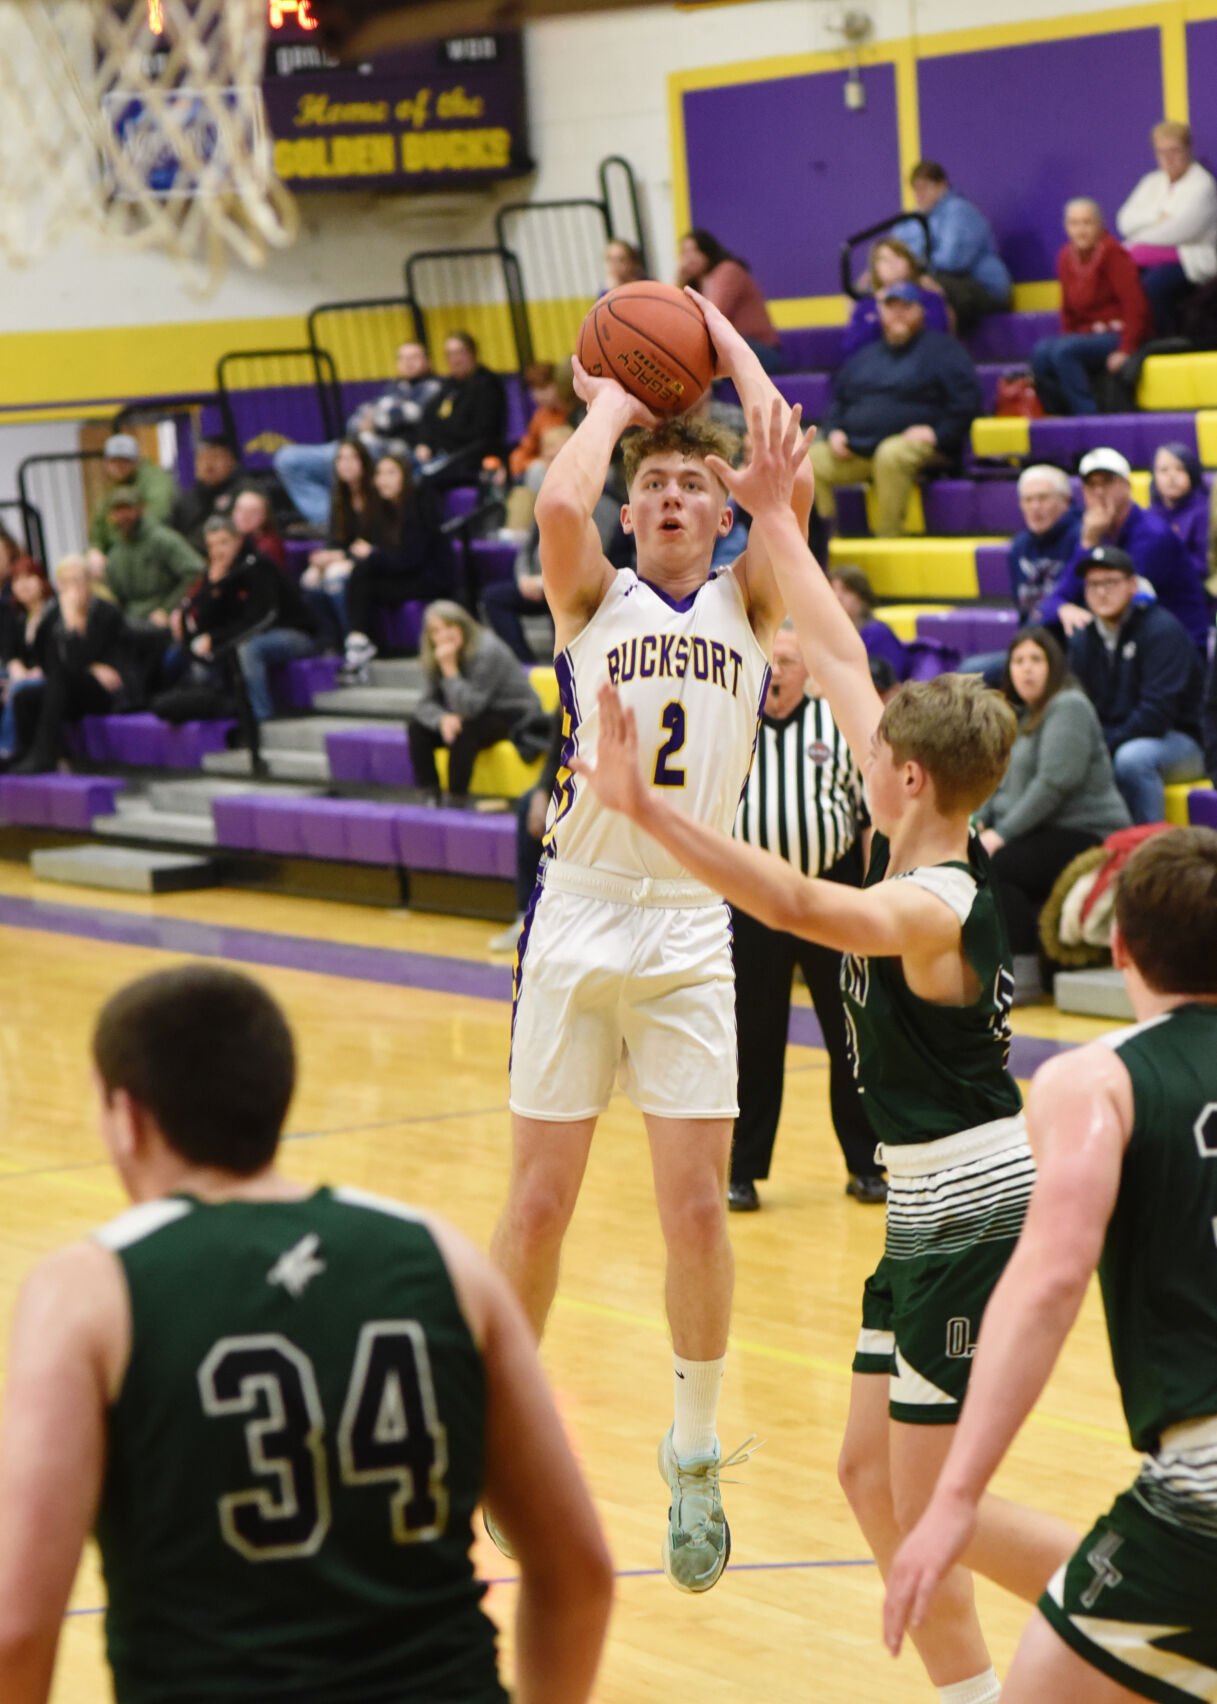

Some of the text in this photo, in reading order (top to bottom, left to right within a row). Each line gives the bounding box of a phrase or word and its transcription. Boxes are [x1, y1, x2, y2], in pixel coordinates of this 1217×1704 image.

[294, 85, 485, 128] Home of the
[651, 699, 688, 788] 2
[197, 1319, 449, 1564] 34
